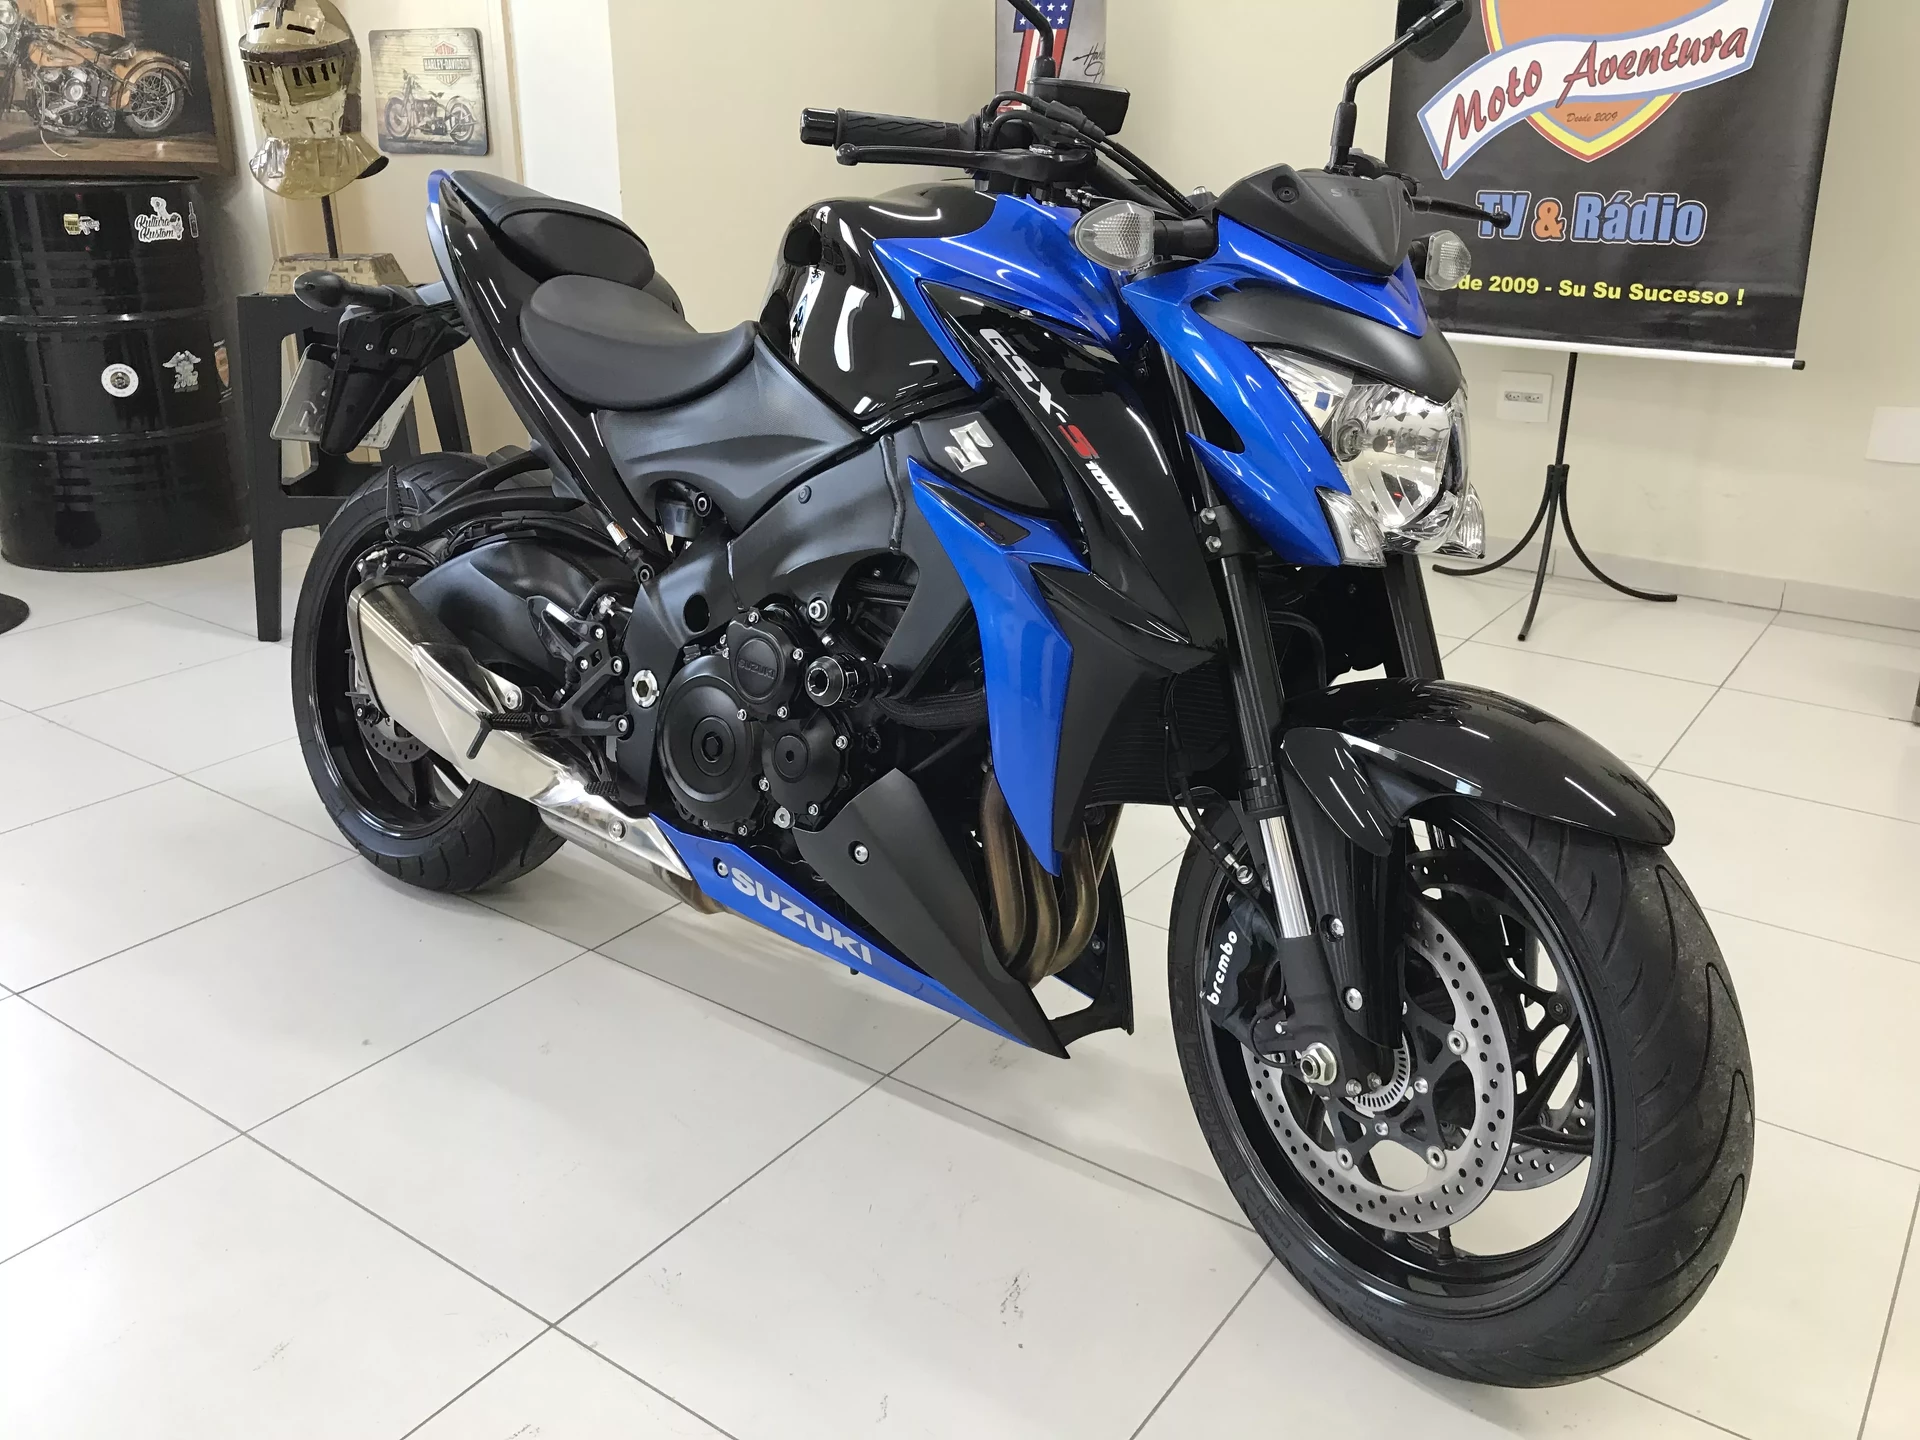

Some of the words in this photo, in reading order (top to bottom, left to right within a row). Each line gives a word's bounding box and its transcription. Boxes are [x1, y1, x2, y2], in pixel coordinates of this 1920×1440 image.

[1442, 60, 1542, 171] Moto
[1555, 27, 1749, 109] Aventura
[1566, 112, 1591, 123] Desde
[1593, 111, 1618, 122] 2009
[1477, 193, 1529, 238] TV
[1533, 199, 1564, 240] &
[1573, 193, 1706, 244] Rádio
[1488, 275, 1539, 294] 2009
[1558, 280, 1586, 298] Su
[1592, 282, 1621, 299] Su
[1628, 284, 1729, 305] Sucesso
[737, 659, 776, 680] SUZUKI
[731, 867, 873, 966] SUZUKI
